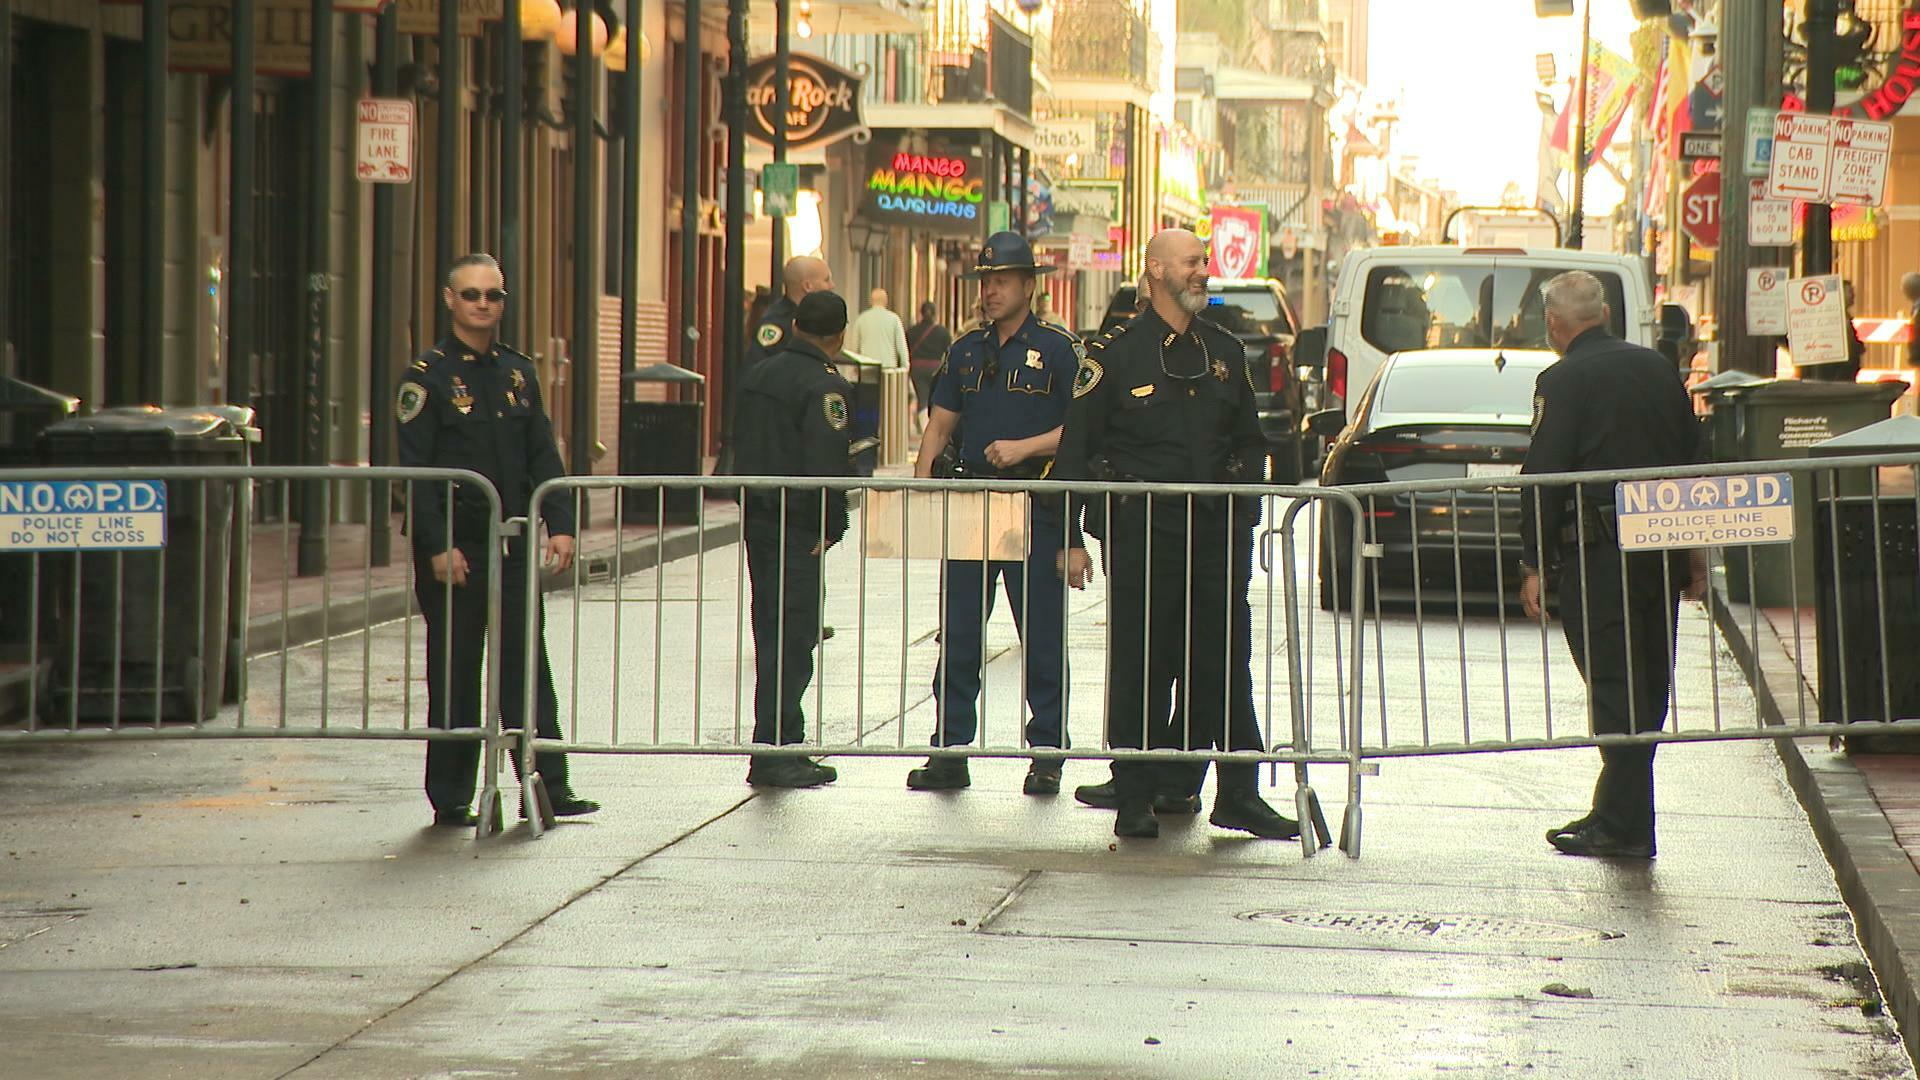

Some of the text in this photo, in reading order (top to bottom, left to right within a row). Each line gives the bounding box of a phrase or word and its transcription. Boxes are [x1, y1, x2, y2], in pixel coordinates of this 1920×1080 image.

[168, 5, 312, 46] GRLL
[791, 77, 852, 112] Rock
[360, 102, 377, 121] NO
[370, 127, 397, 141] FIRE
[1775, 118, 1792, 138] NO
[1792, 122, 1830, 137] PARKING
[1835, 124, 1888, 144] NO PARKING
[367, 144, 400, 158] LANE
[1687, 142, 1713, 155] ONE
[1788, 146, 1813, 161] CAB
[893, 152, 966, 178] MANGO
[1836, 150, 1884, 165] FREIGHT
[1778, 165, 1819, 181] STAND
[1843, 164, 1873, 177] ZONE
[1686, 194, 1720, 225] ST
[1777, 204, 1788, 212] PM
[1768, 214, 1777, 223] TO
[23, 516, 134, 530] POLICE LINE
[1648, 512, 1763, 528] POLICE LINE
[11, 530, 145, 544] DO NOT CROSS
[1635, 526, 1778, 544] DO NOT CROSS
